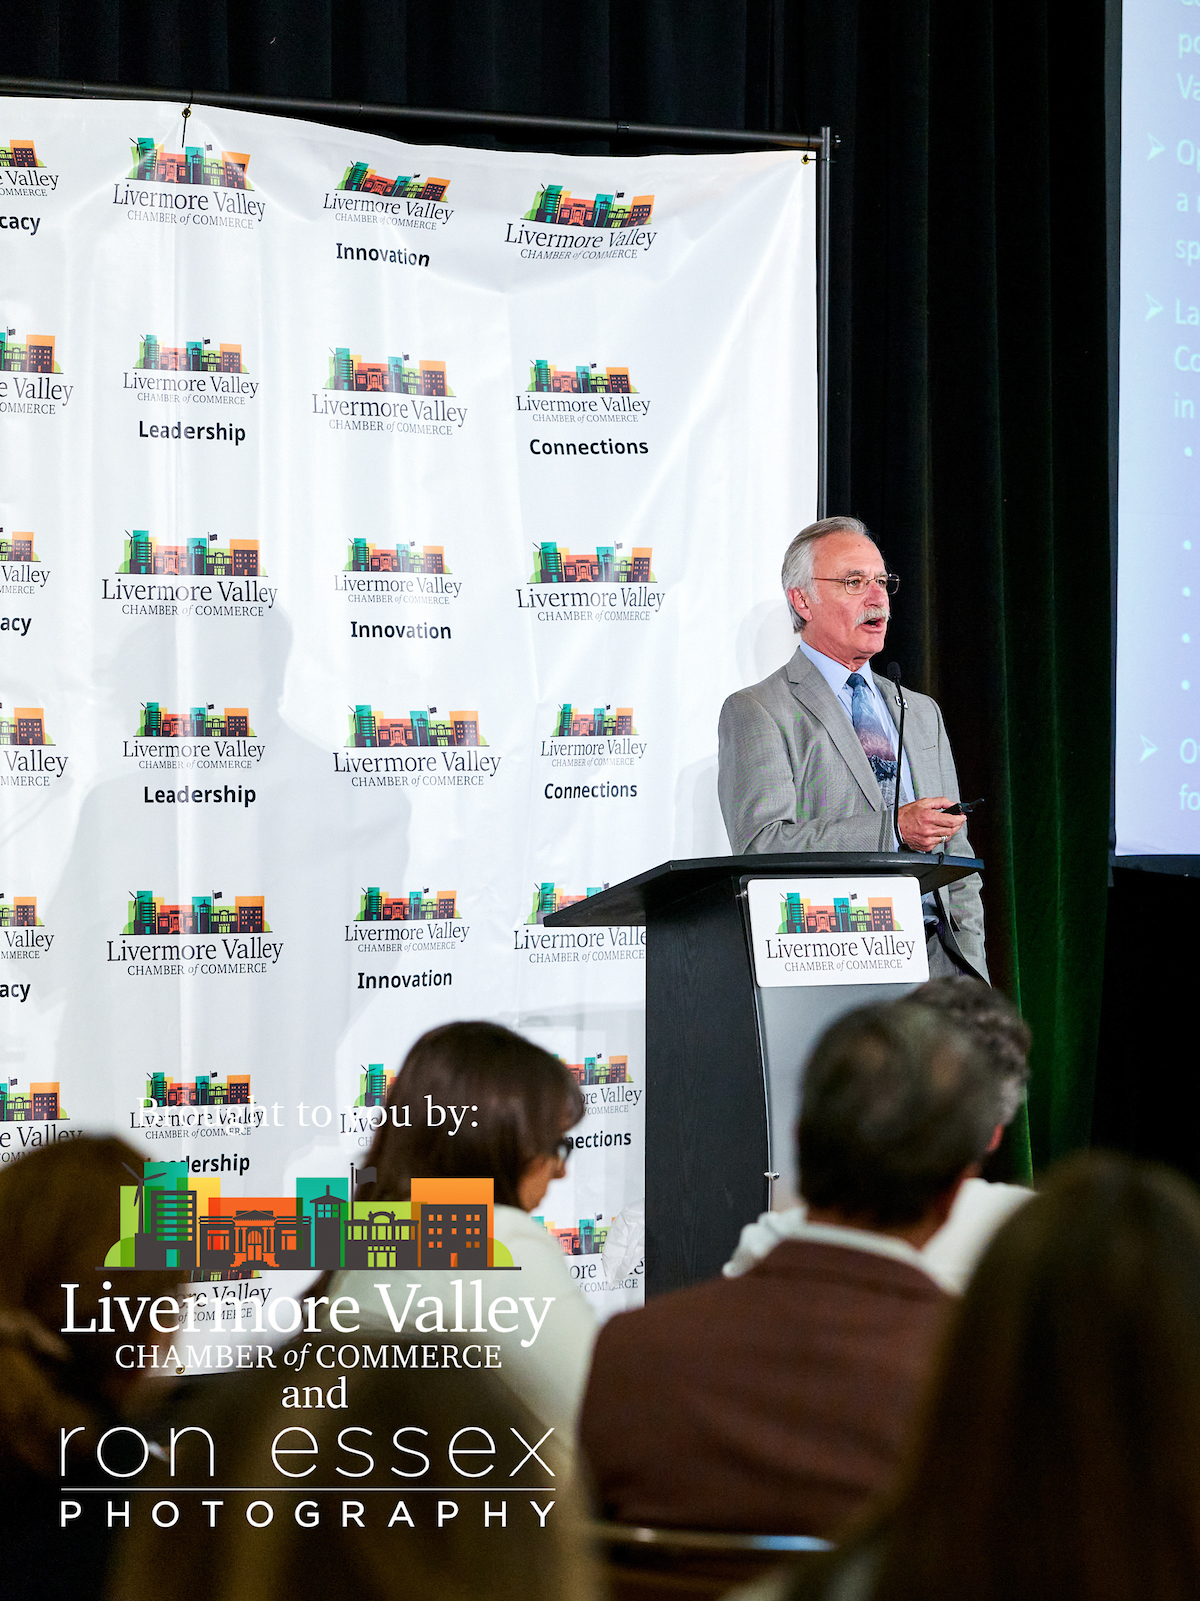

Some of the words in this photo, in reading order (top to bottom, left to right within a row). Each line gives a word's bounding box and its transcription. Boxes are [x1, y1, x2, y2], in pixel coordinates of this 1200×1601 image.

[5, 170, 59, 191] Valley
[113, 184, 208, 210] Livermore
[213, 191, 266, 224] Valley
[323, 193, 400, 215] Livermore
[406, 201, 454, 227] Valley
[1176, 192, 1189, 212] a
[127, 210, 178, 224] CHAMBER
[192, 214, 253, 229] COMMERCE
[335, 213, 378, 223] CHAMBER
[387, 217, 437, 230] COMMERCE
[505, 223, 603, 248] Livermore
[609, 228, 657, 251] Valley
[336, 243, 430, 267] Innovation
[520, 249, 571, 259] CHAMBER
[582, 249, 637, 259] COMMERCE
[13, 377, 73, 406] Valley
[123, 372, 206, 392] Livermore
[210, 376, 259, 399] Valley
[137, 392, 180, 403] CHAMBER
[192, 395, 245, 405] COMMERCE
[516, 395, 598, 412] Livermore
[600, 396, 650, 416] Valley
[1174, 392, 1193, 419] in
[312, 394, 408, 418] Livermore
[411, 400, 468, 429] Valley
[532, 414, 576, 422] CHAMBER
[139, 421, 245, 446] Leadership
[329, 420, 384, 431] CHAMBER
[397, 422, 453, 435] COMMERCE
[530, 438, 648, 455] Connections
[1, 565, 51, 589] Valley
[335, 575, 413, 592] Livermore
[416, 577, 462, 598] Valley
[102, 578, 212, 601] Livermore
[217, 580, 277, 609] Valley
[348, 594, 393, 603] CHAMBER
[403, 595, 450, 605] COMMERCE
[516, 588, 617, 608] Livermore
[621, 586, 665, 614] Valley
[122, 605, 178, 615] CHAMBER
[195, 606, 264, 617] COMMERCE
[537, 611, 593, 621] CHAMBER
[604, 611, 650, 621] COMMERCE
[351, 621, 451, 639] Innovation
[123, 740, 210, 757] Livermore
[214, 740, 265, 762] Valley
[540, 740, 604, 756] Livermore
[607, 738, 647, 759] Valley
[4, 749, 68, 779] Valley
[139, 761, 183, 769] CHAMBER
[197, 760, 252, 769] COMMERCE
[333, 752, 436, 772] Livermore
[441, 750, 501, 777] Valley
[552, 758, 586, 767] CHAMBER
[593, 757, 634, 766] COMMERCE
[351, 776, 408, 787] CHAMBER
[422, 776, 484, 785] COMMERCE
[544, 781, 637, 799] Connections
[144, 785, 256, 808] Leadership
[4, 930, 55, 952] Valley
[345, 924, 423, 941] Livermore
[427, 921, 470, 943] Valley
[514, 929, 604, 950] Livermore
[608, 927, 646, 946] Valle
[107, 940, 216, 961] Livermore
[221, 937, 284, 964] Valley
[358, 944, 402, 952] CHAMBER
[412, 941, 456, 951] COMMERCE
[529, 952, 580, 963] CHAMBER
[592, 949, 644, 961] COMMERCE
[765, 938, 858, 958] Livermore
[861, 935, 915, 961] Valley
[127, 965, 184, 975] CHAMBER
[201, 963, 267, 974] COMMERCE
[784, 961, 835, 972] CHAMBER
[836, 960, 845, 971] of
[846, 959, 902, 970] COMMERCE
[357, 969, 452, 989] Innovation
[600, 1085, 643, 1106] Valley
